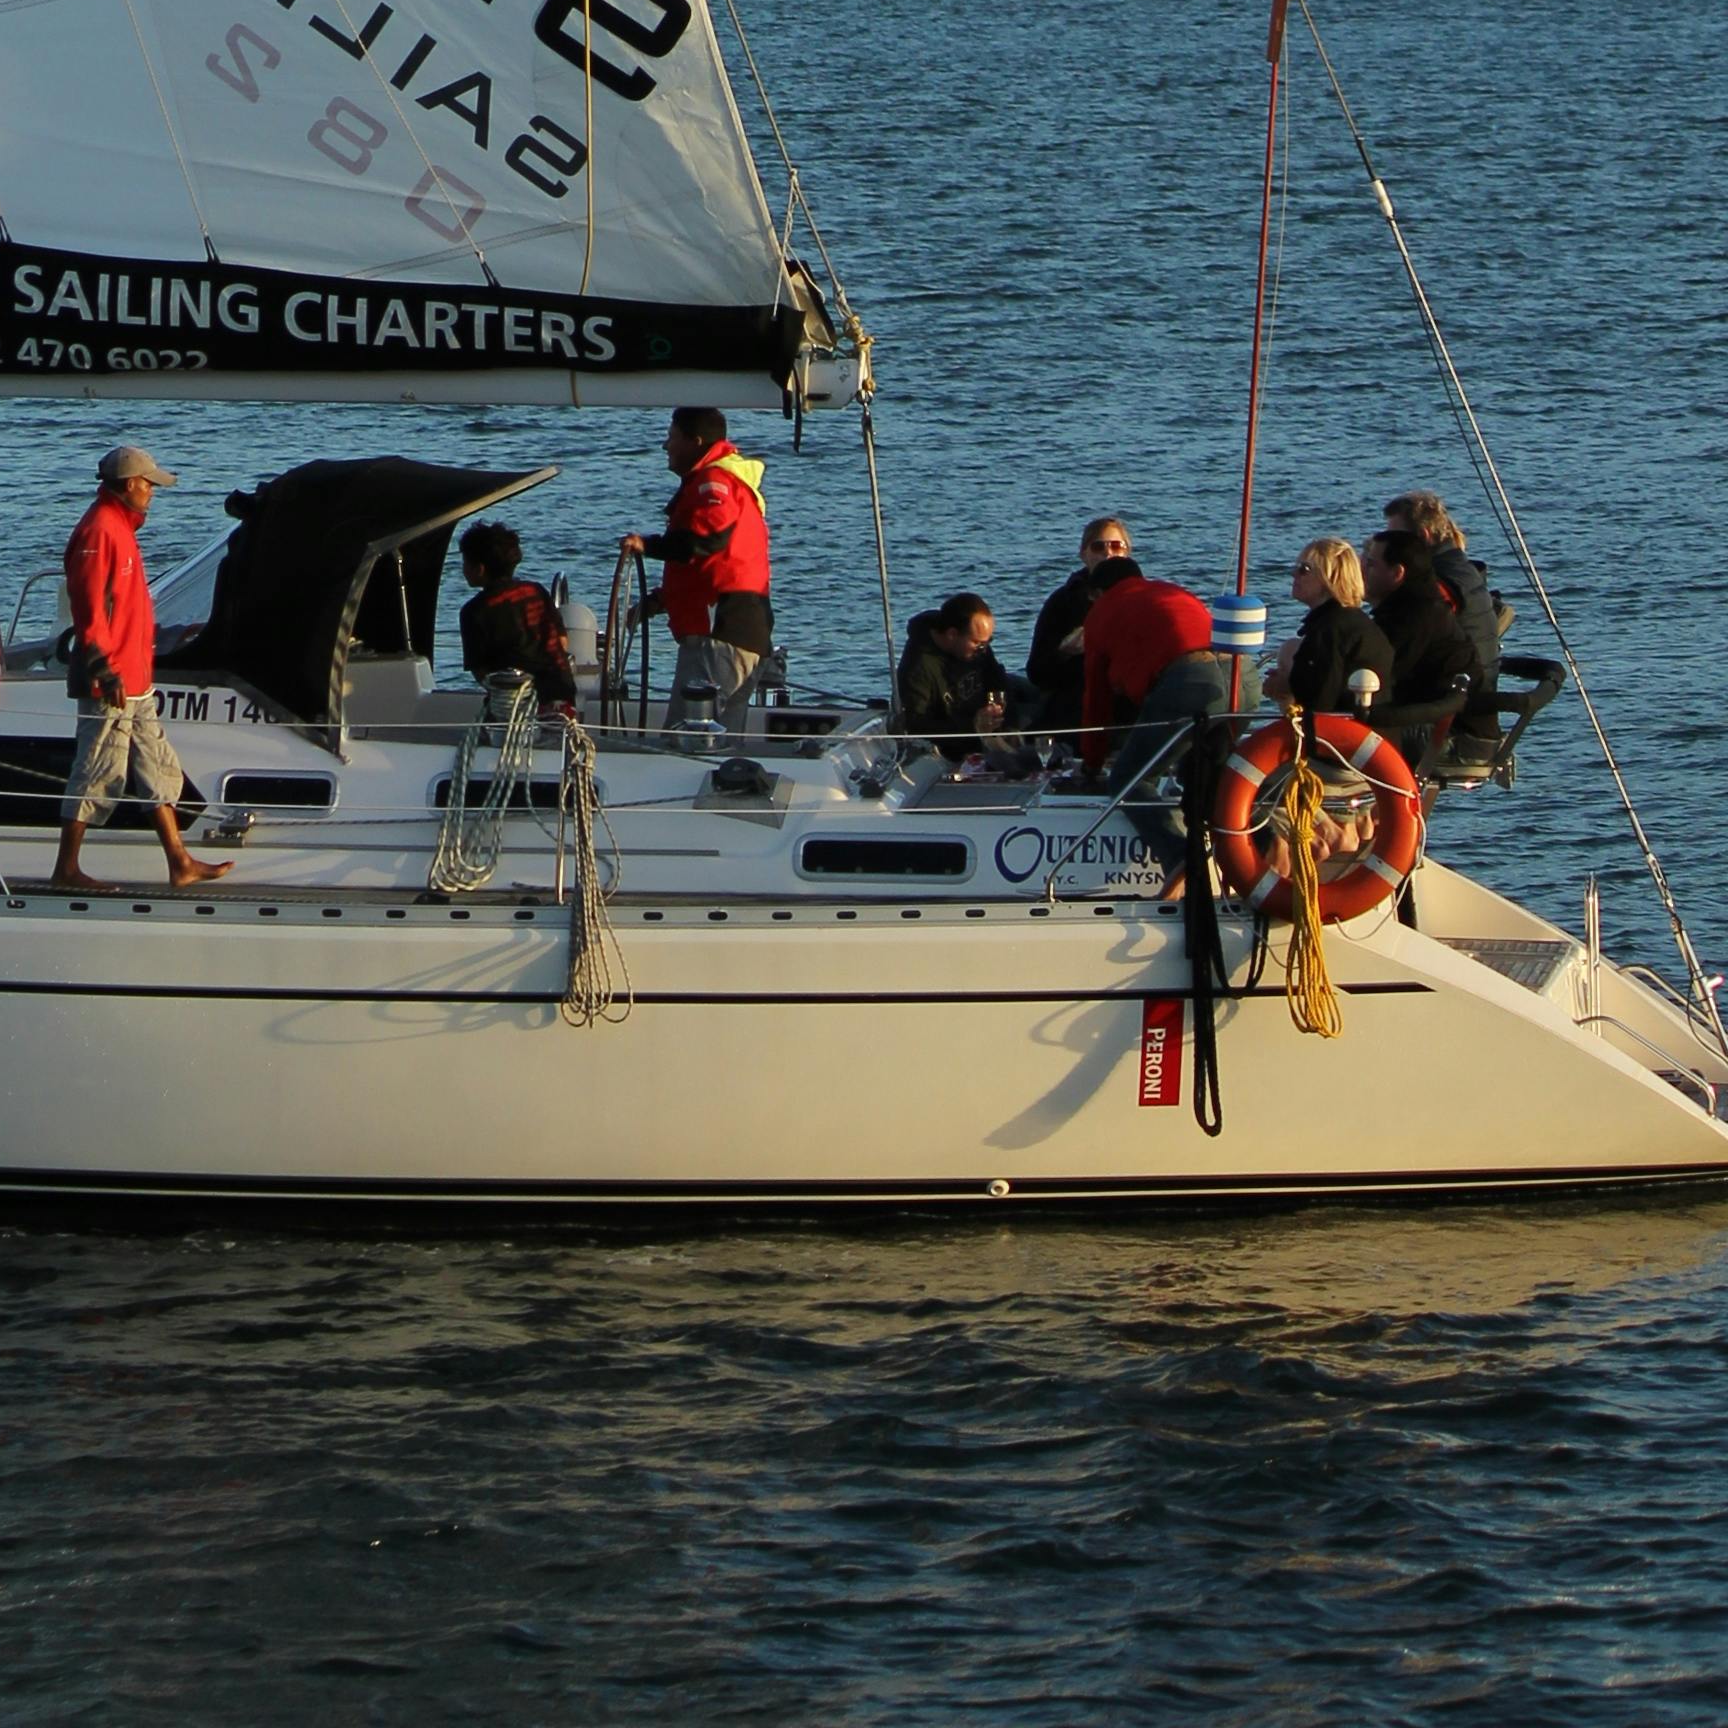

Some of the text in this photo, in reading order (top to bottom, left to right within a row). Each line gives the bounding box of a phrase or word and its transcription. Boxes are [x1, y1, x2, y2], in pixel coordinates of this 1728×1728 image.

[14, 264, 260, 332] SAILING
[284, 291, 617, 362] CHARTERS
[17, 337, 93, 370] 470
[106, 347, 209, 370] 6022
[1144, 1027, 1167, 1099] PERONI
